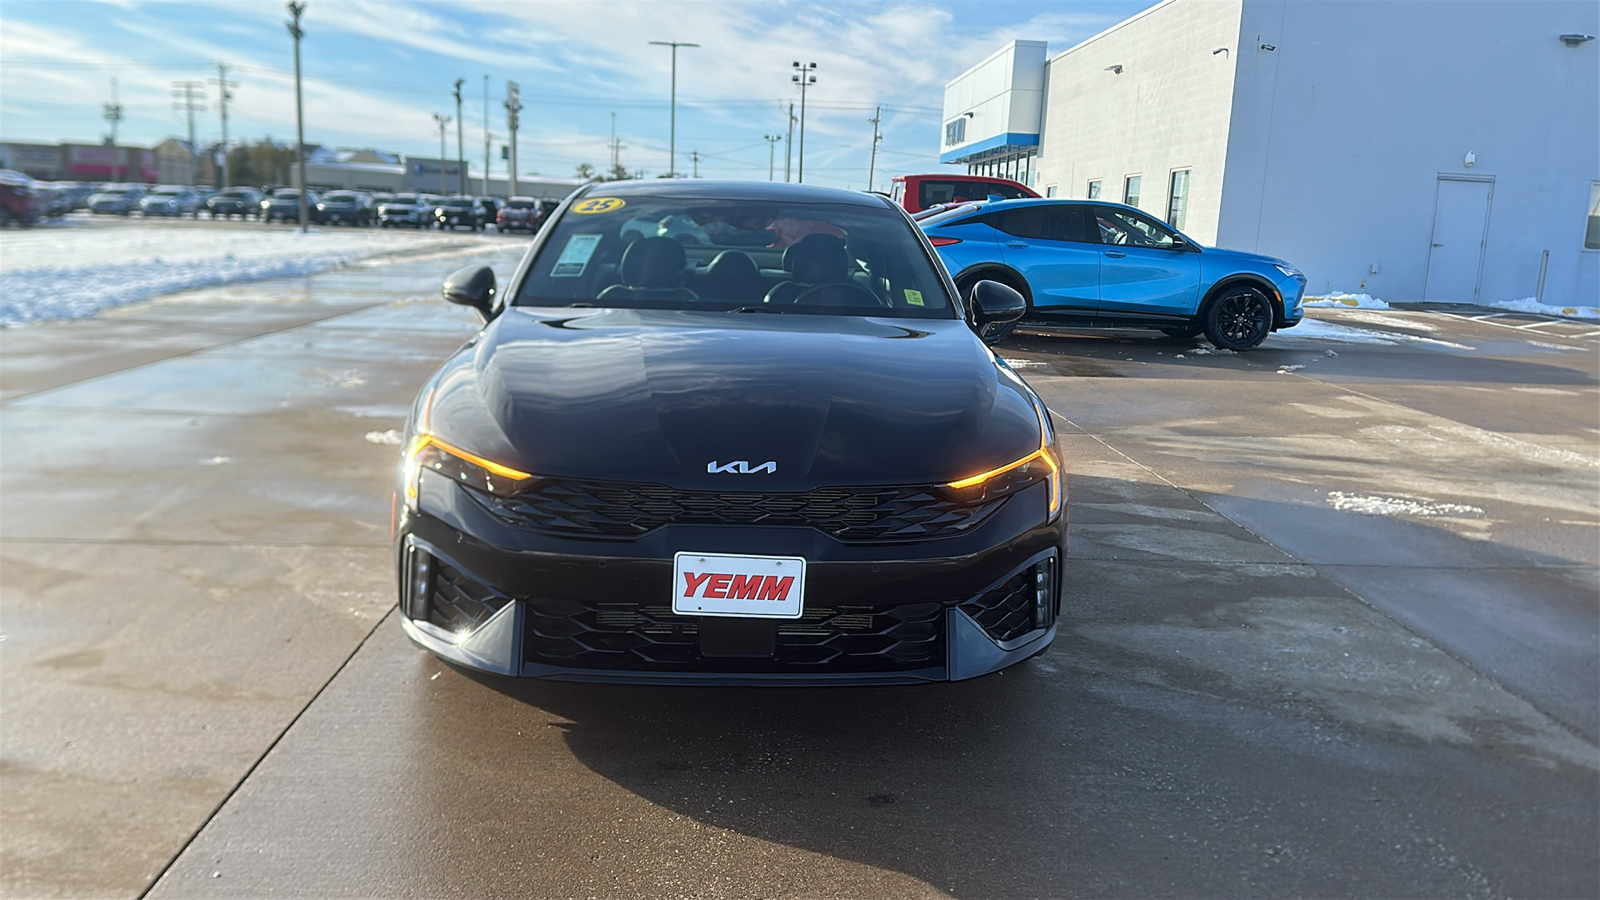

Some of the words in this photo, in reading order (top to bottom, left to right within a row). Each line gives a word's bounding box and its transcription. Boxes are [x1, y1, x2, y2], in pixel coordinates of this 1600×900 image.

[581, 199, 614, 211] 25
[707, 460, 777, 474] KIA
[683, 572, 795, 601] YEMM
